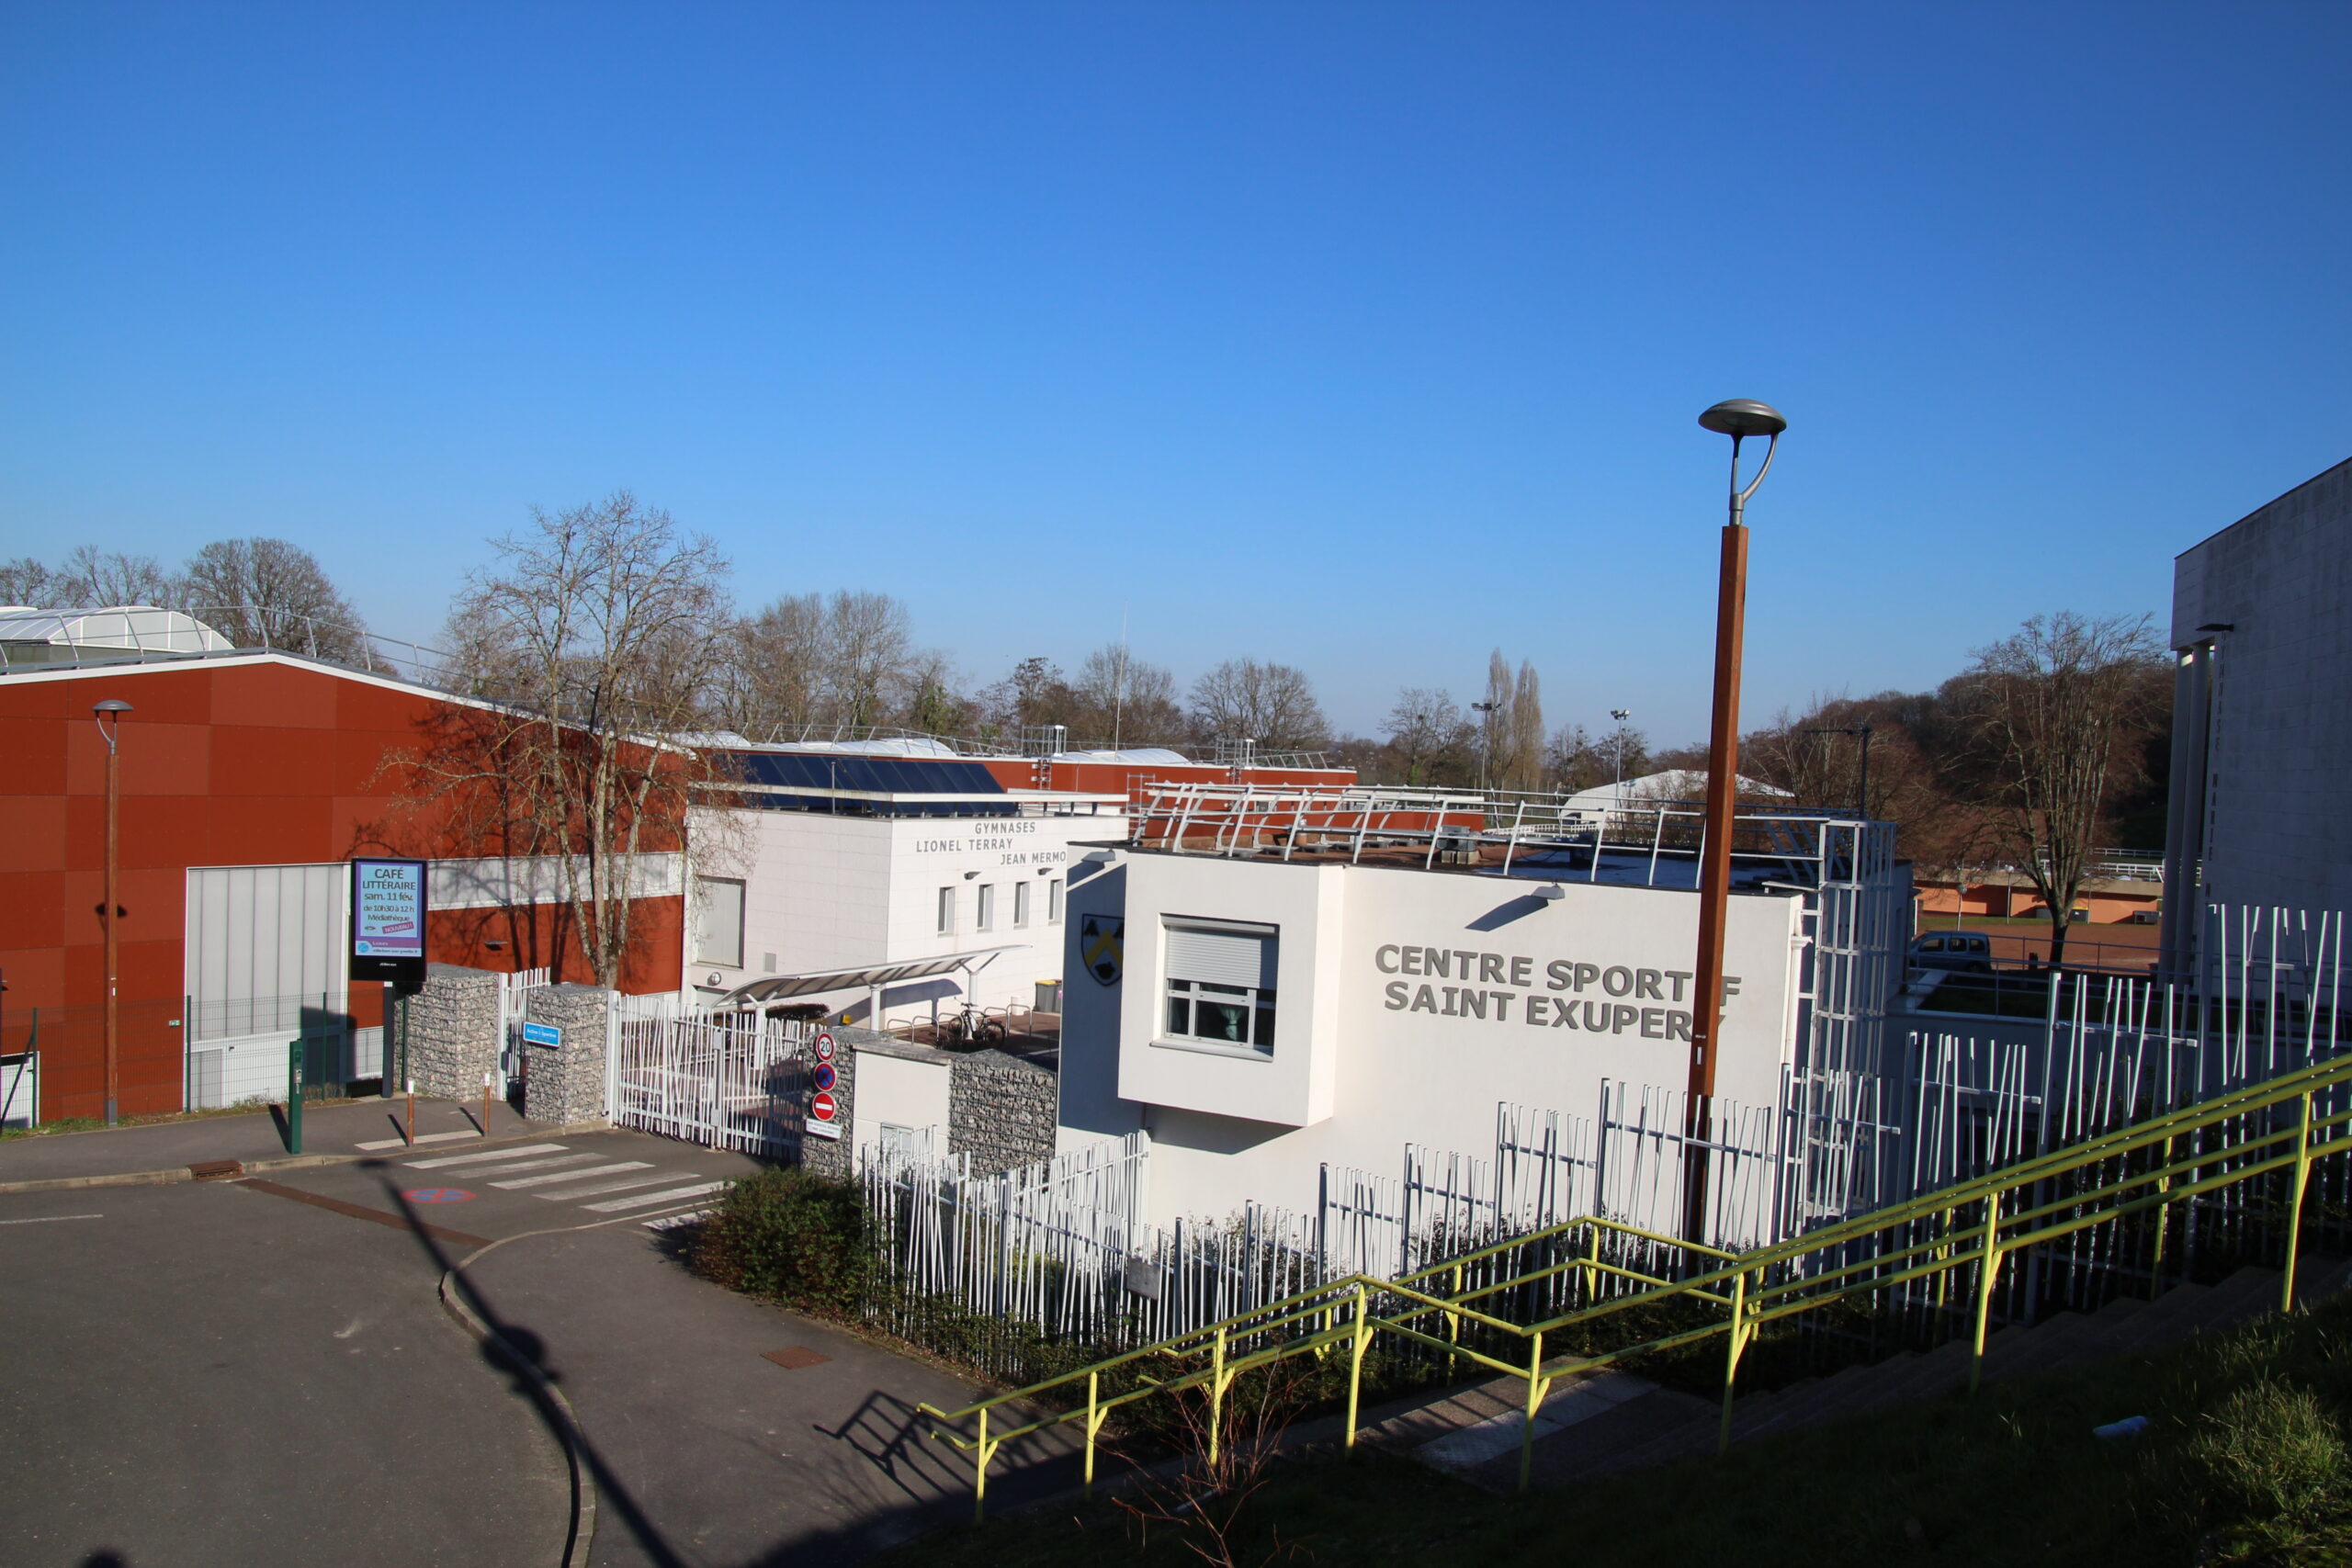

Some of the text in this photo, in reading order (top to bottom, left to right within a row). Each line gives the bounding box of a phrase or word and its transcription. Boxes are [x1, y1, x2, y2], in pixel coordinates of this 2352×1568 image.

[975, 822, 1035, 834] GYMNASES
[916, 838, 1012, 852] LIONEL TERRAY
[1001, 851, 1066, 865] JEAN MERMO
[375, 867, 404, 879] CAFÉ
[362, 879, 416, 890] LITTÉRAIRE
[387, 892, 397, 901] 11
[399, 892, 413, 901] fév.
[368, 914, 410, 922] Médiathèque
[1374, 944, 1742, 1006] CENTRE SPORTF
[1384, 980, 1726, 1043] SAINT EXUPER
[820, 1041, 831, 1053] 20
